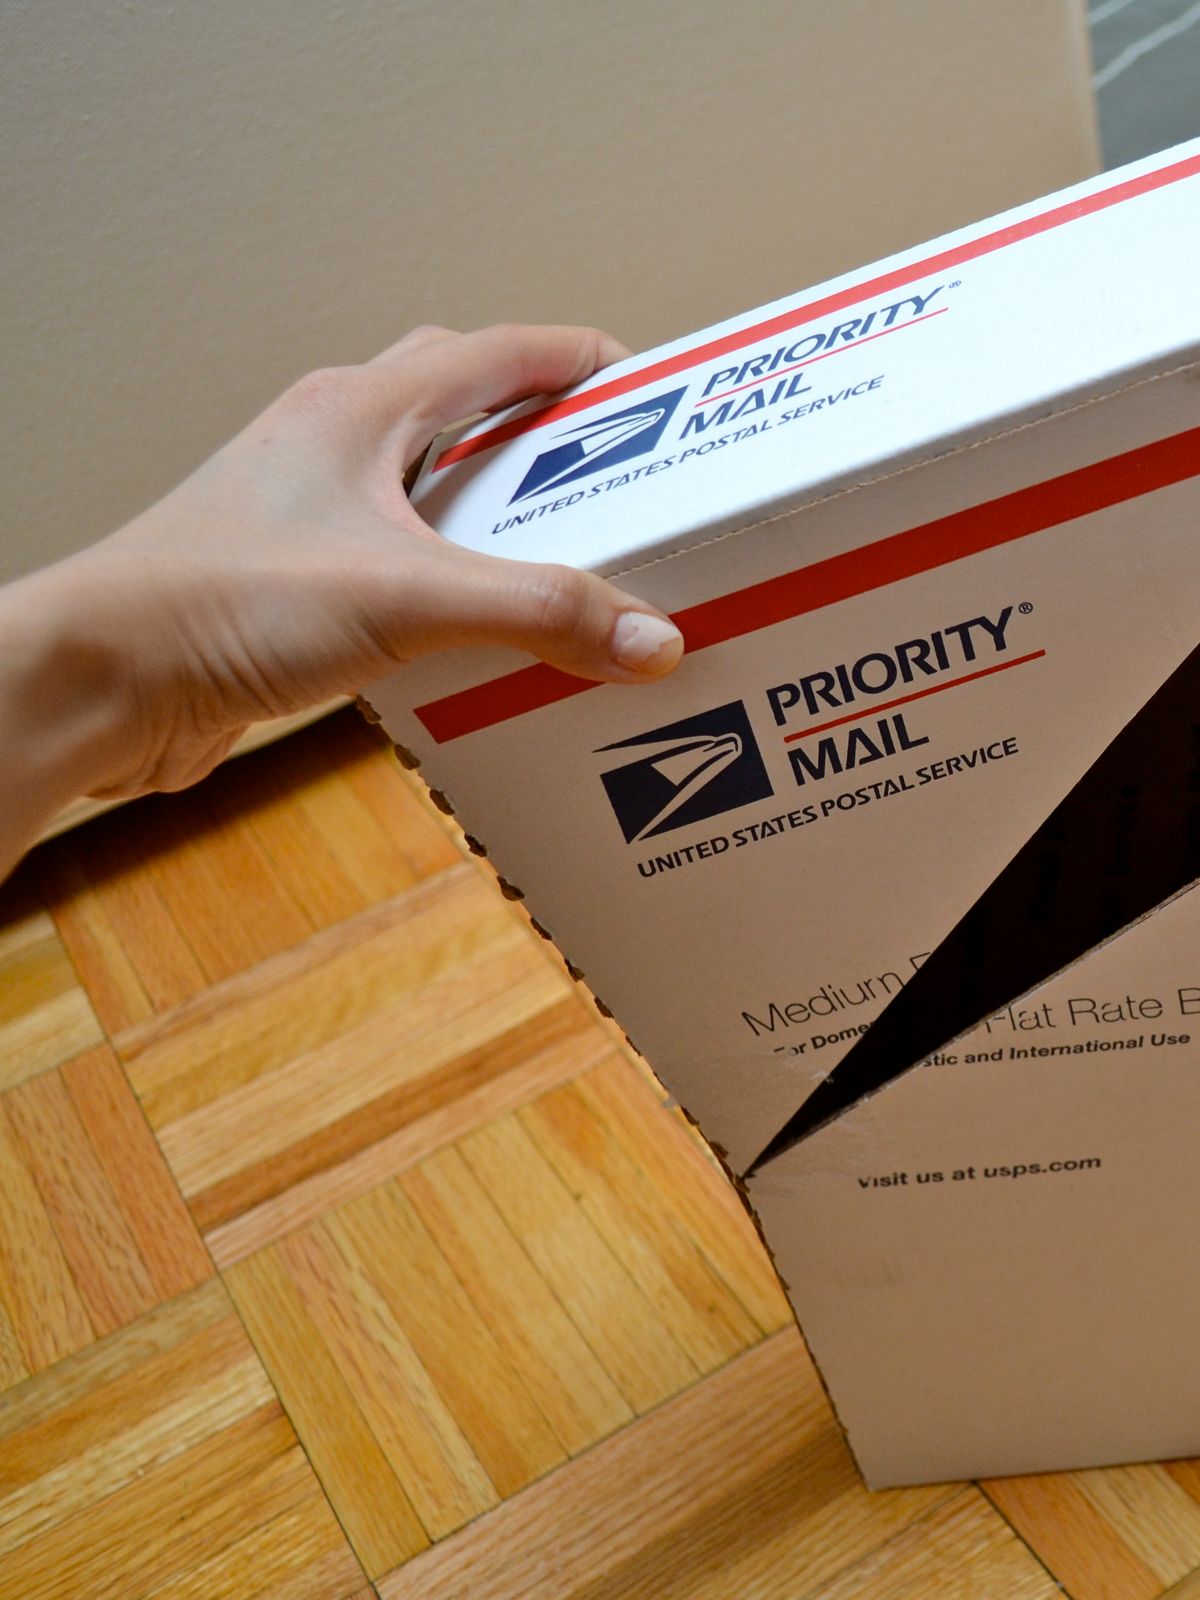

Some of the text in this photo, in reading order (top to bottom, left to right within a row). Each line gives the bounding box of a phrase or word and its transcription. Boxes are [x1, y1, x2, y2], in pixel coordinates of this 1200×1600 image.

[679, 372, 812, 441] MAIL
[492, 376, 885, 535] UNITED STATES POSTAL SERVICE
[787, 713, 930, 787] MAIL
[638, 737, 1020, 878] UNITED STATES POSTAL SERVICE
[1067, 995, 1163, 1026] Rate
[964, 1048, 1003, 1063] and
[1009, 1035, 1144, 1060] International
[1150, 1033, 1191, 1047] Use
[916, 1171, 944, 1184] us
[951, 1166, 977, 1181] at
[983, 1157, 1102, 1180] usps.com
